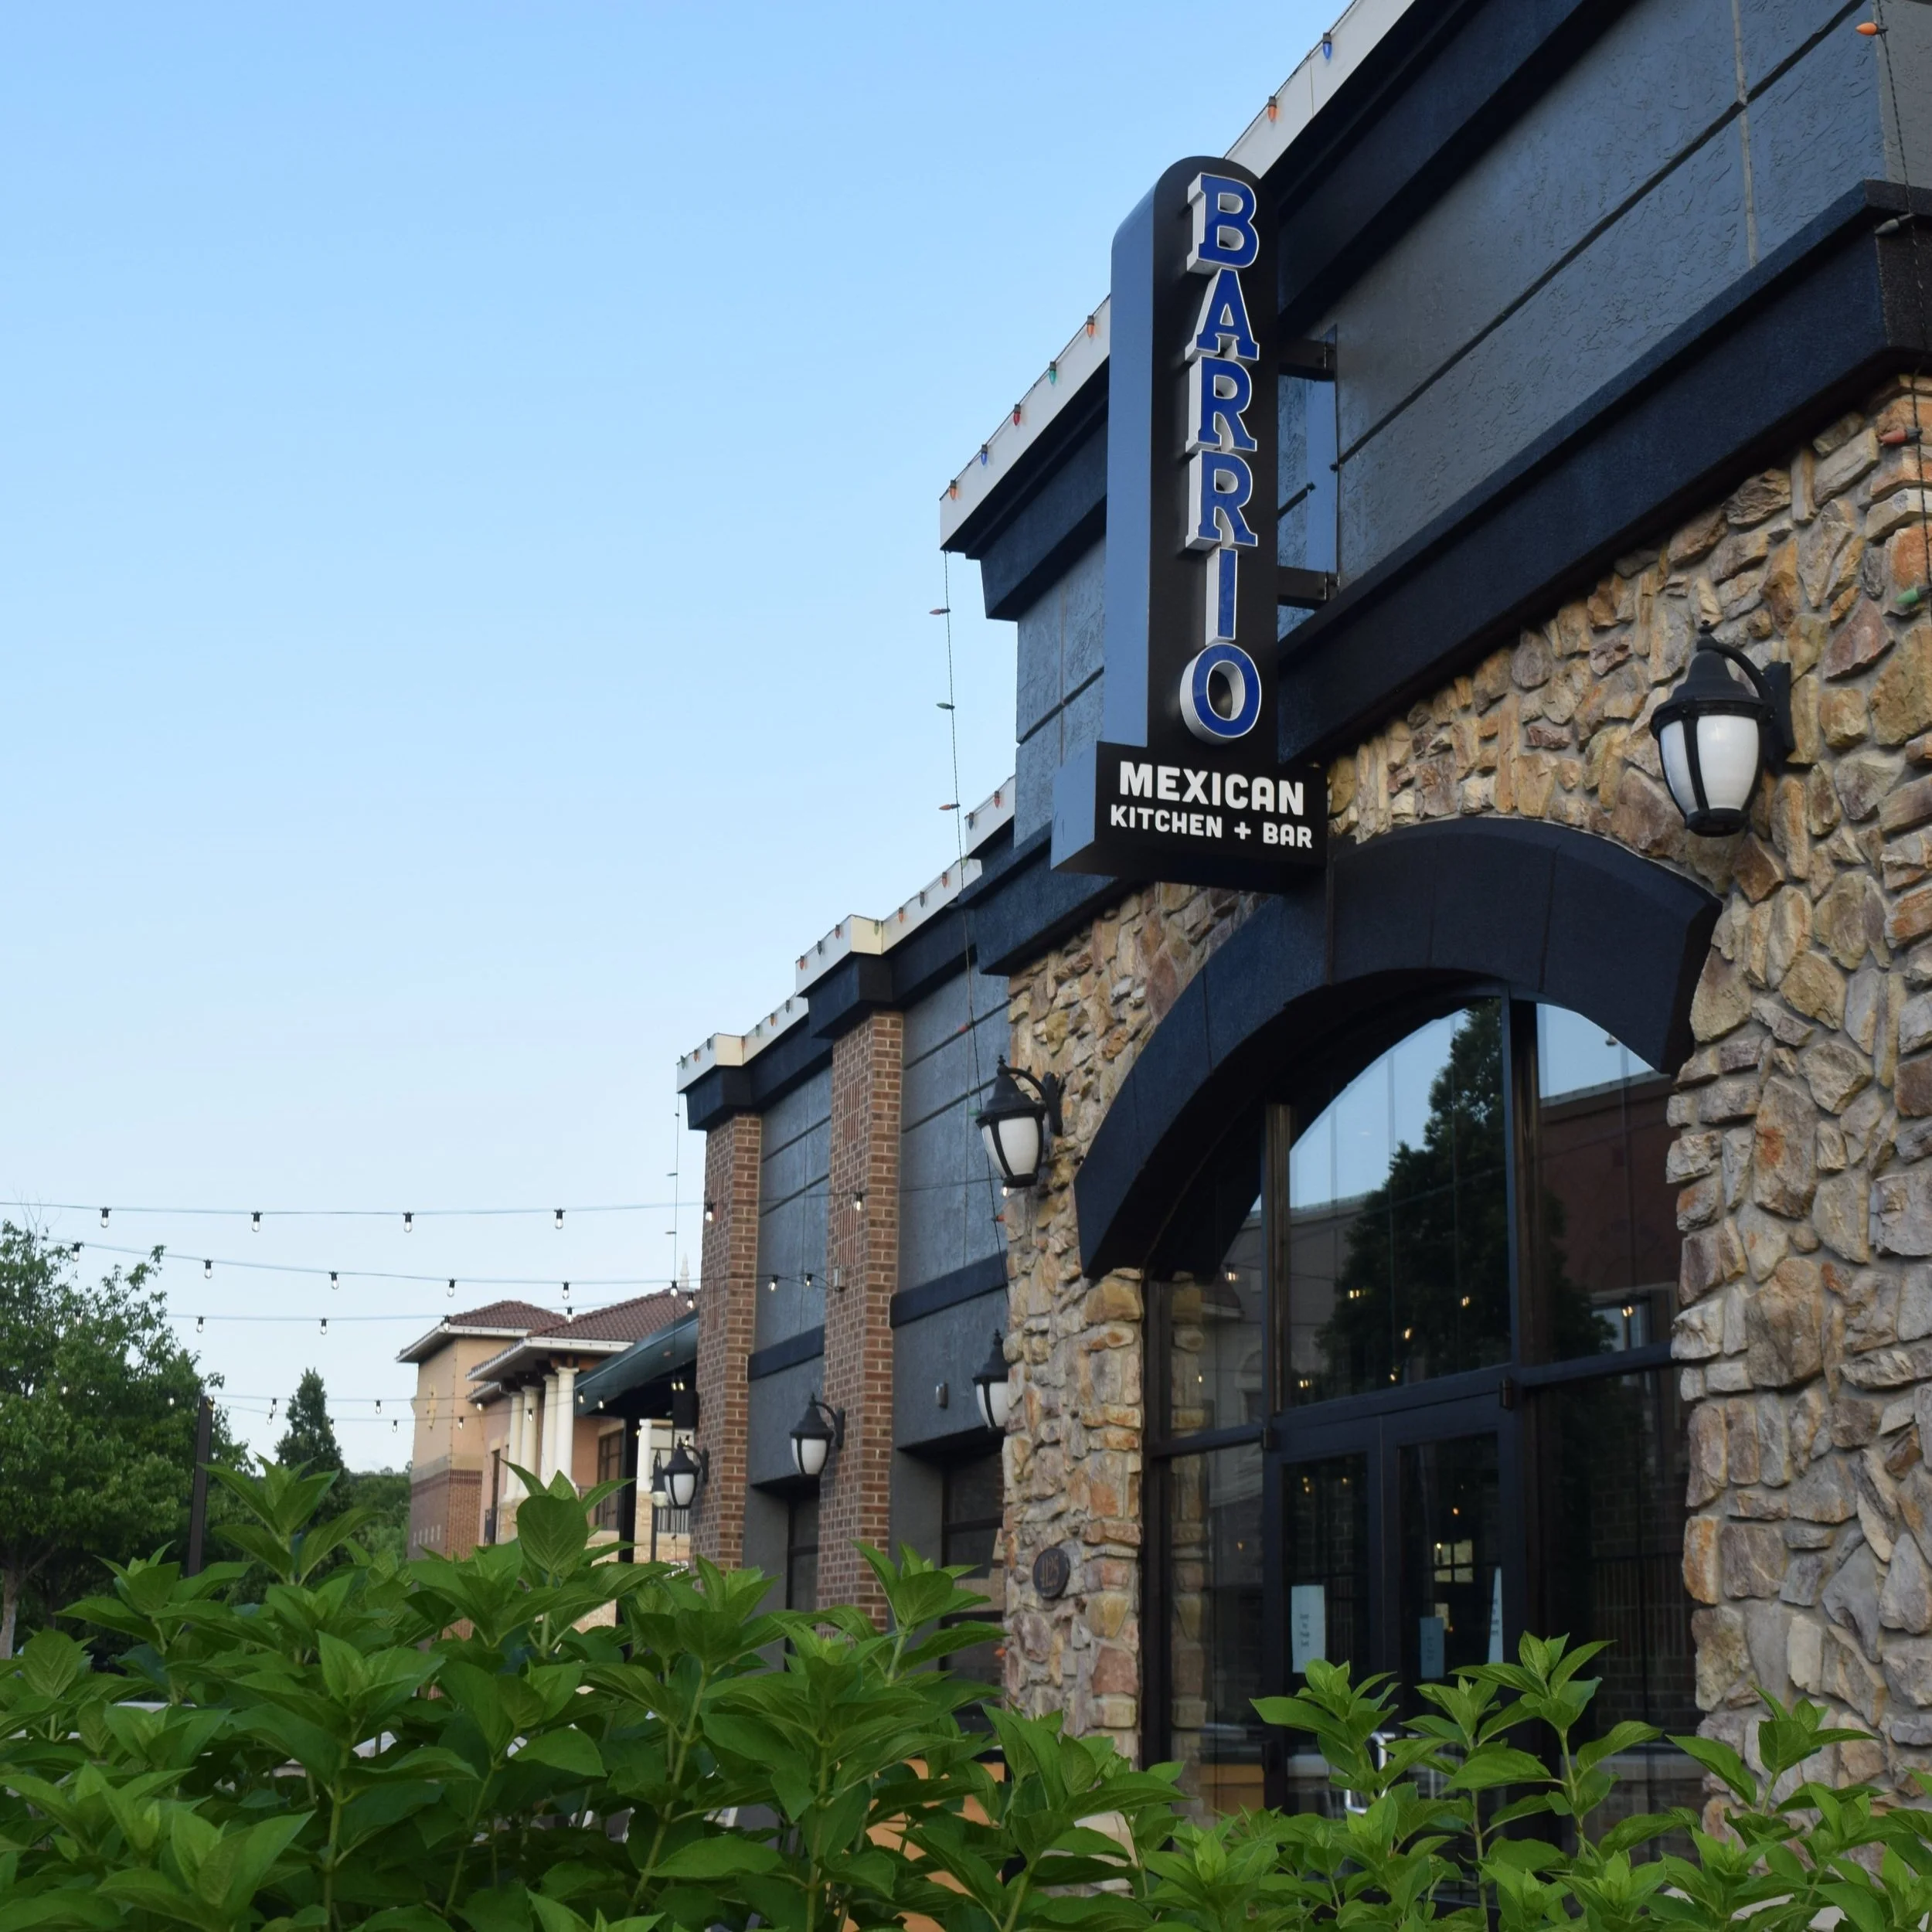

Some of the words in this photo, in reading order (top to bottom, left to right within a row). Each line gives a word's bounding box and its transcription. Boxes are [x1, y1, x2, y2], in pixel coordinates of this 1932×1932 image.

[1180, 172, 1261, 744] BARRIO
[1120, 760, 1304, 815] MEXICAN
[1111, 804, 1223, 838] KITCHEN
[1234, 821, 1251, 840] +
[1263, 821, 1312, 849] BAR
